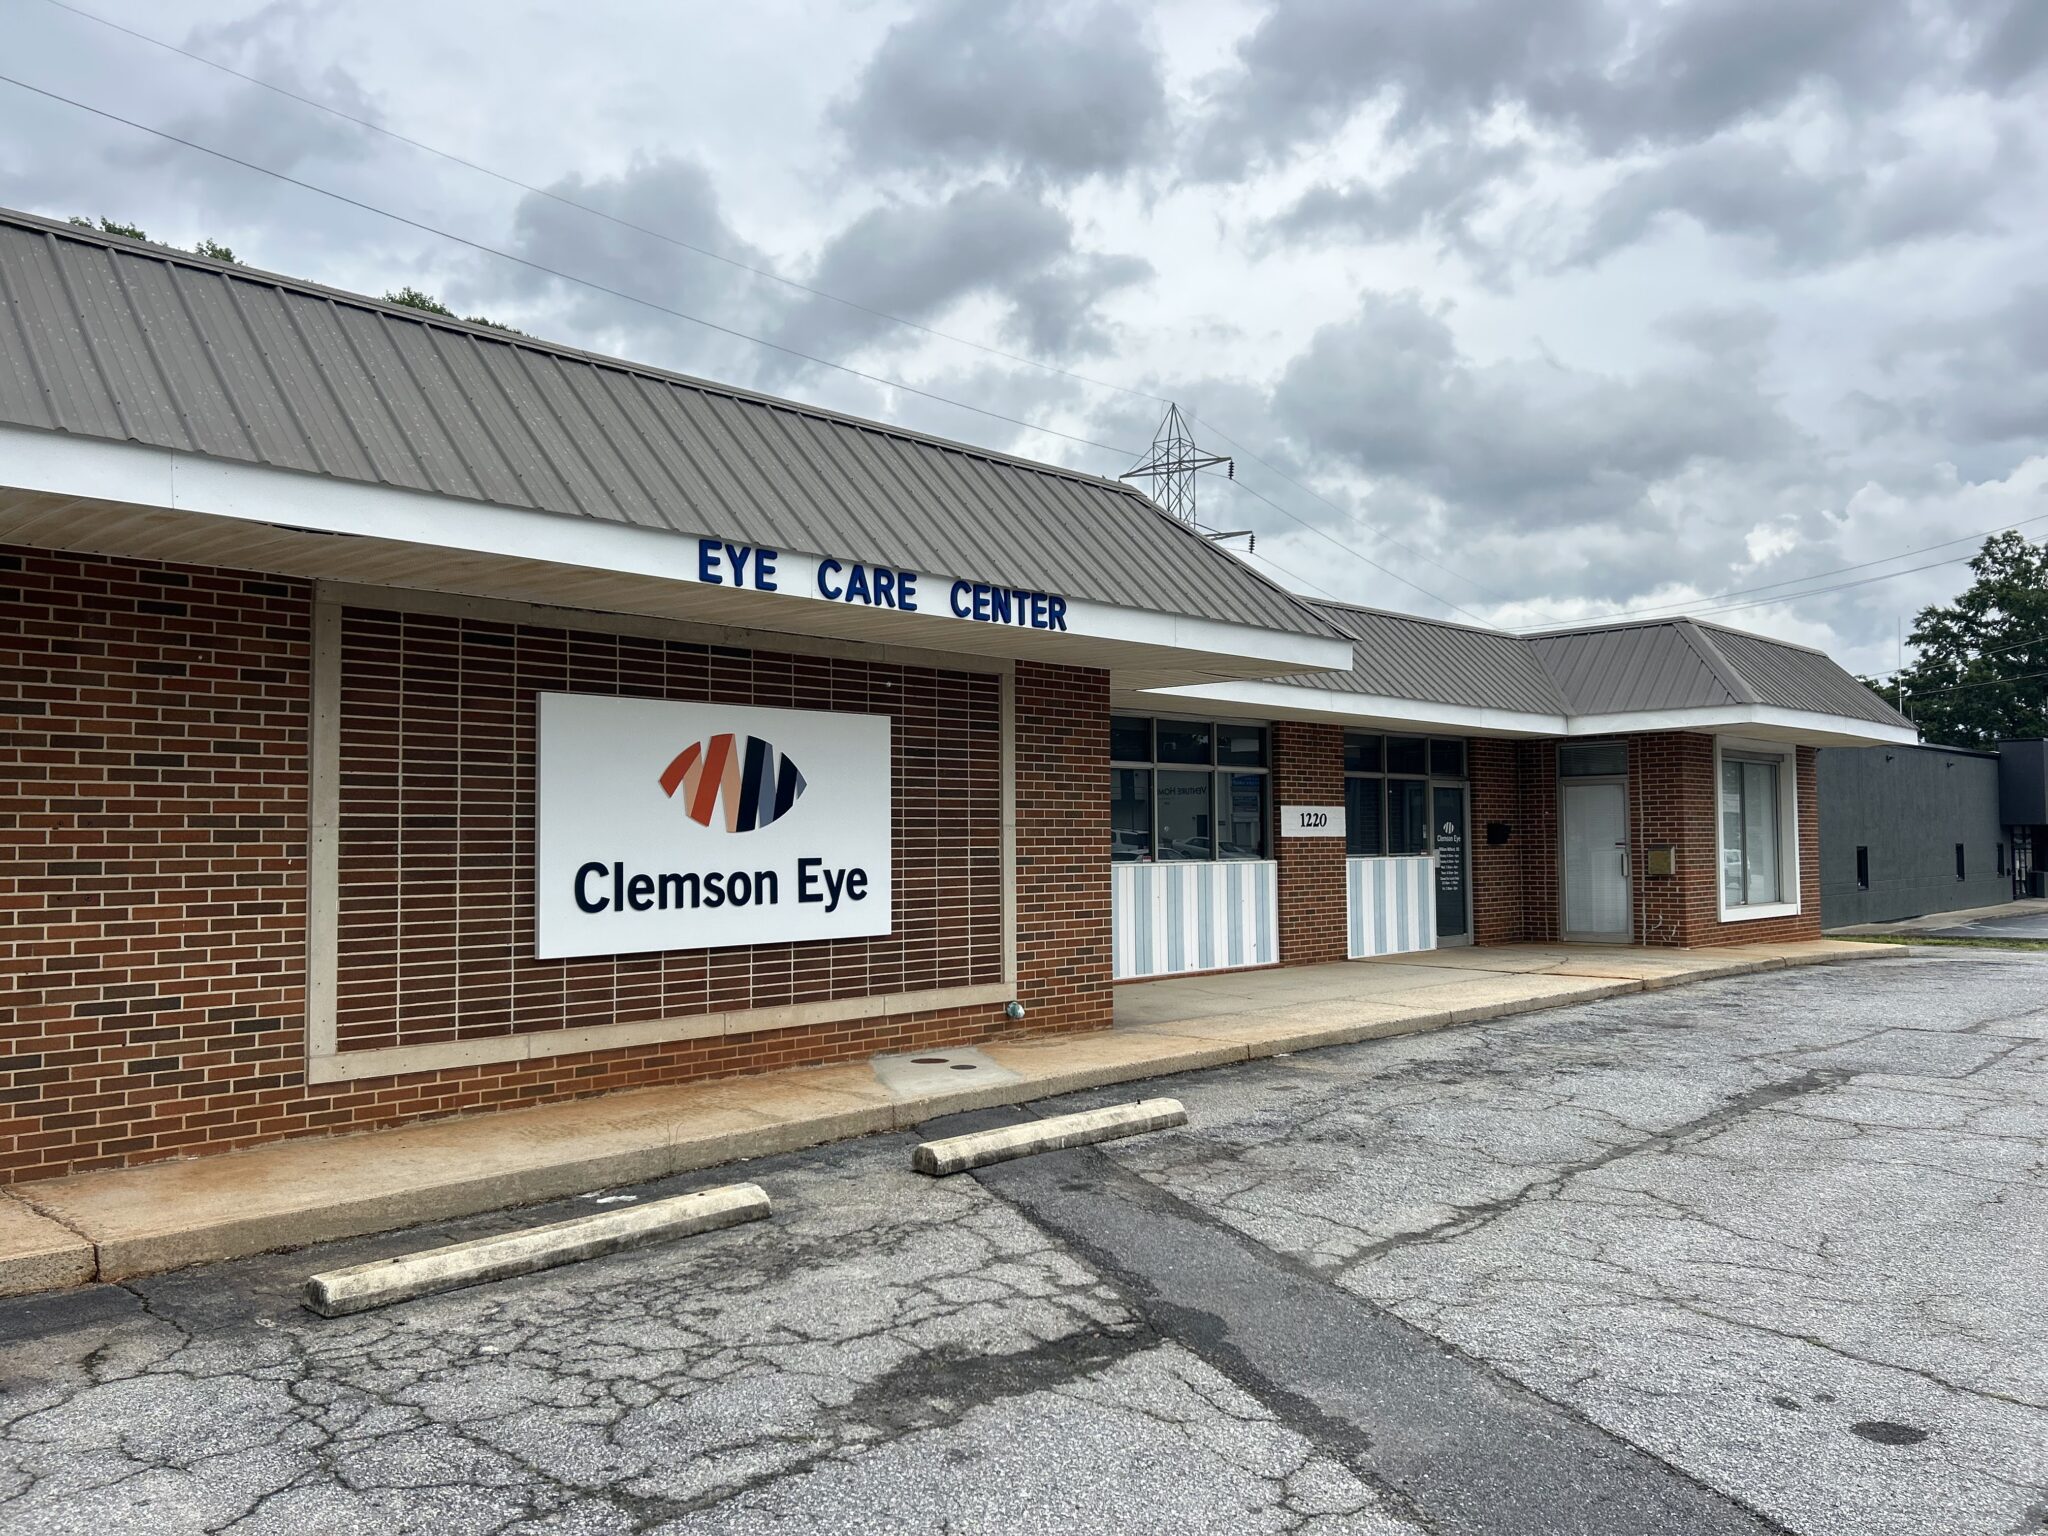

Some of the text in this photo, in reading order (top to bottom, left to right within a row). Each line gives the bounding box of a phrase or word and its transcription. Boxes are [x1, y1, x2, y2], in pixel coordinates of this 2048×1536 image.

[699, 539, 1068, 631] EYE CARE CENTER
[1300, 812, 1328, 828] 1220
[574, 857, 868, 914] Clemson Eye
